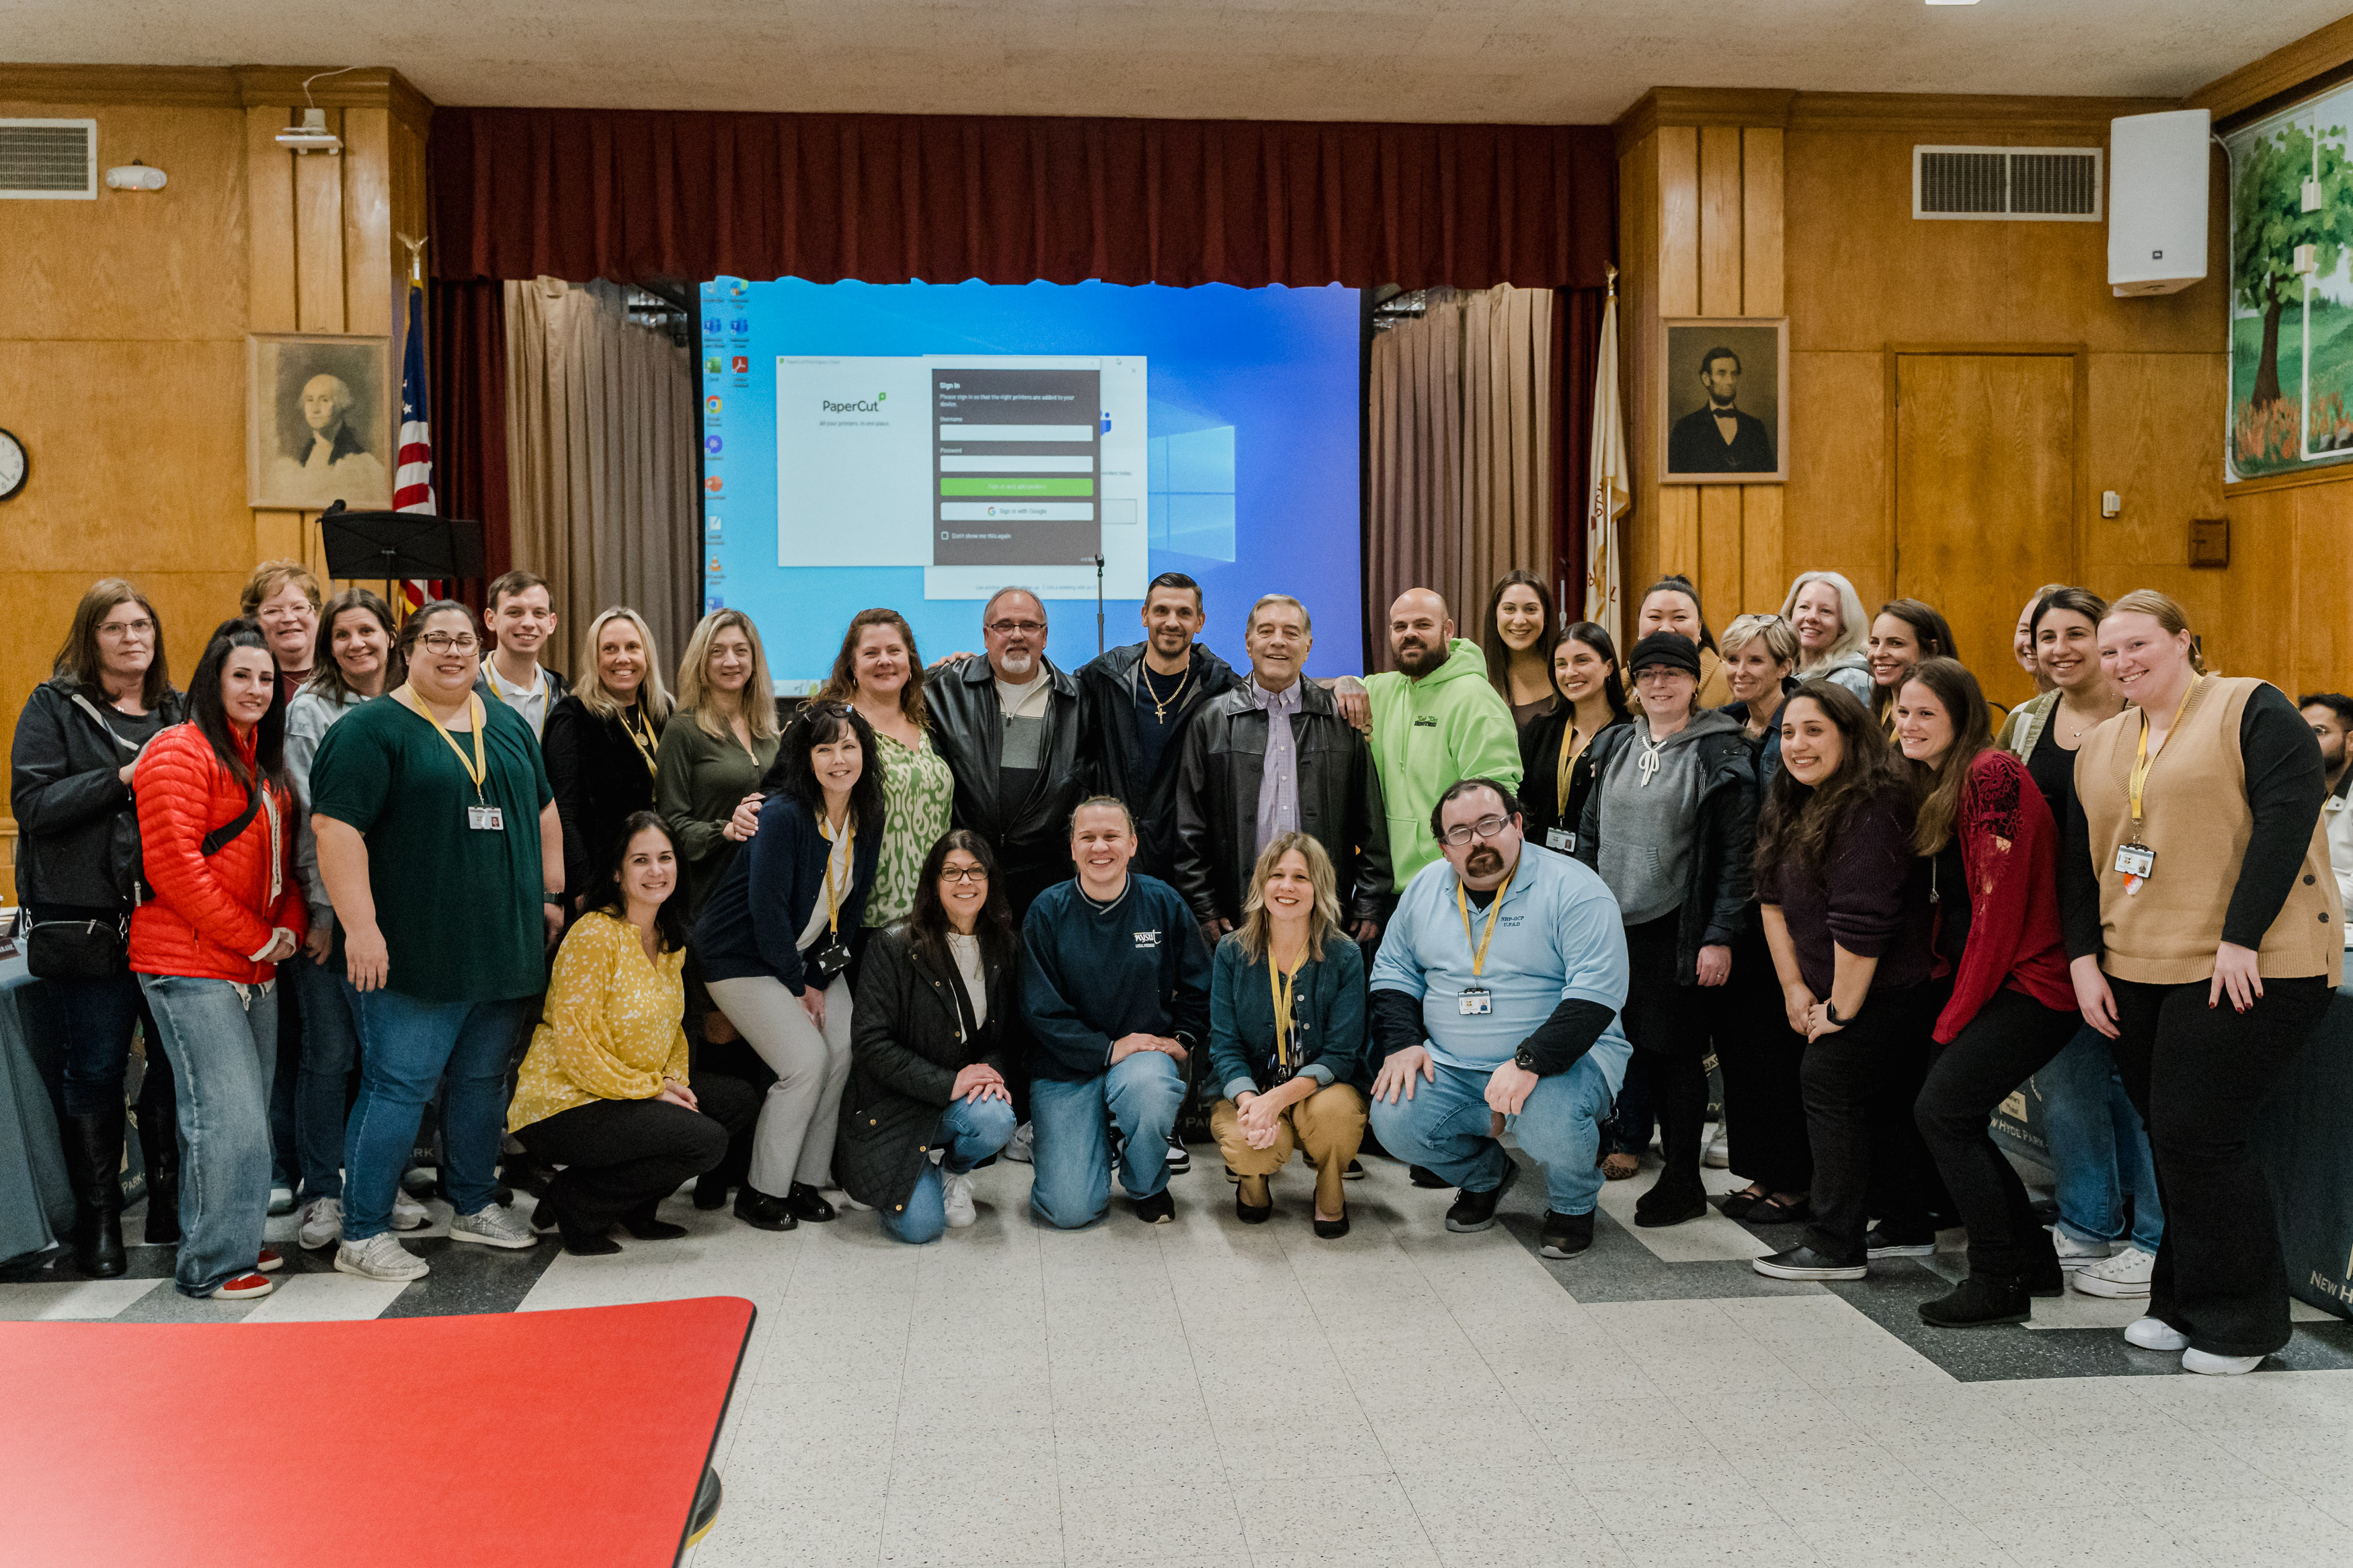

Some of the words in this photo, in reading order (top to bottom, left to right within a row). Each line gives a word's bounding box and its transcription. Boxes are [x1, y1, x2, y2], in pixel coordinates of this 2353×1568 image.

[823, 401, 879, 413] PaperCut
[1133, 930, 1162, 944] nysut
[1999, 1120, 2022, 1139] HYDE
[122, 1171, 143, 1194] PARK
[2310, 1270, 2338, 1296] NEW
